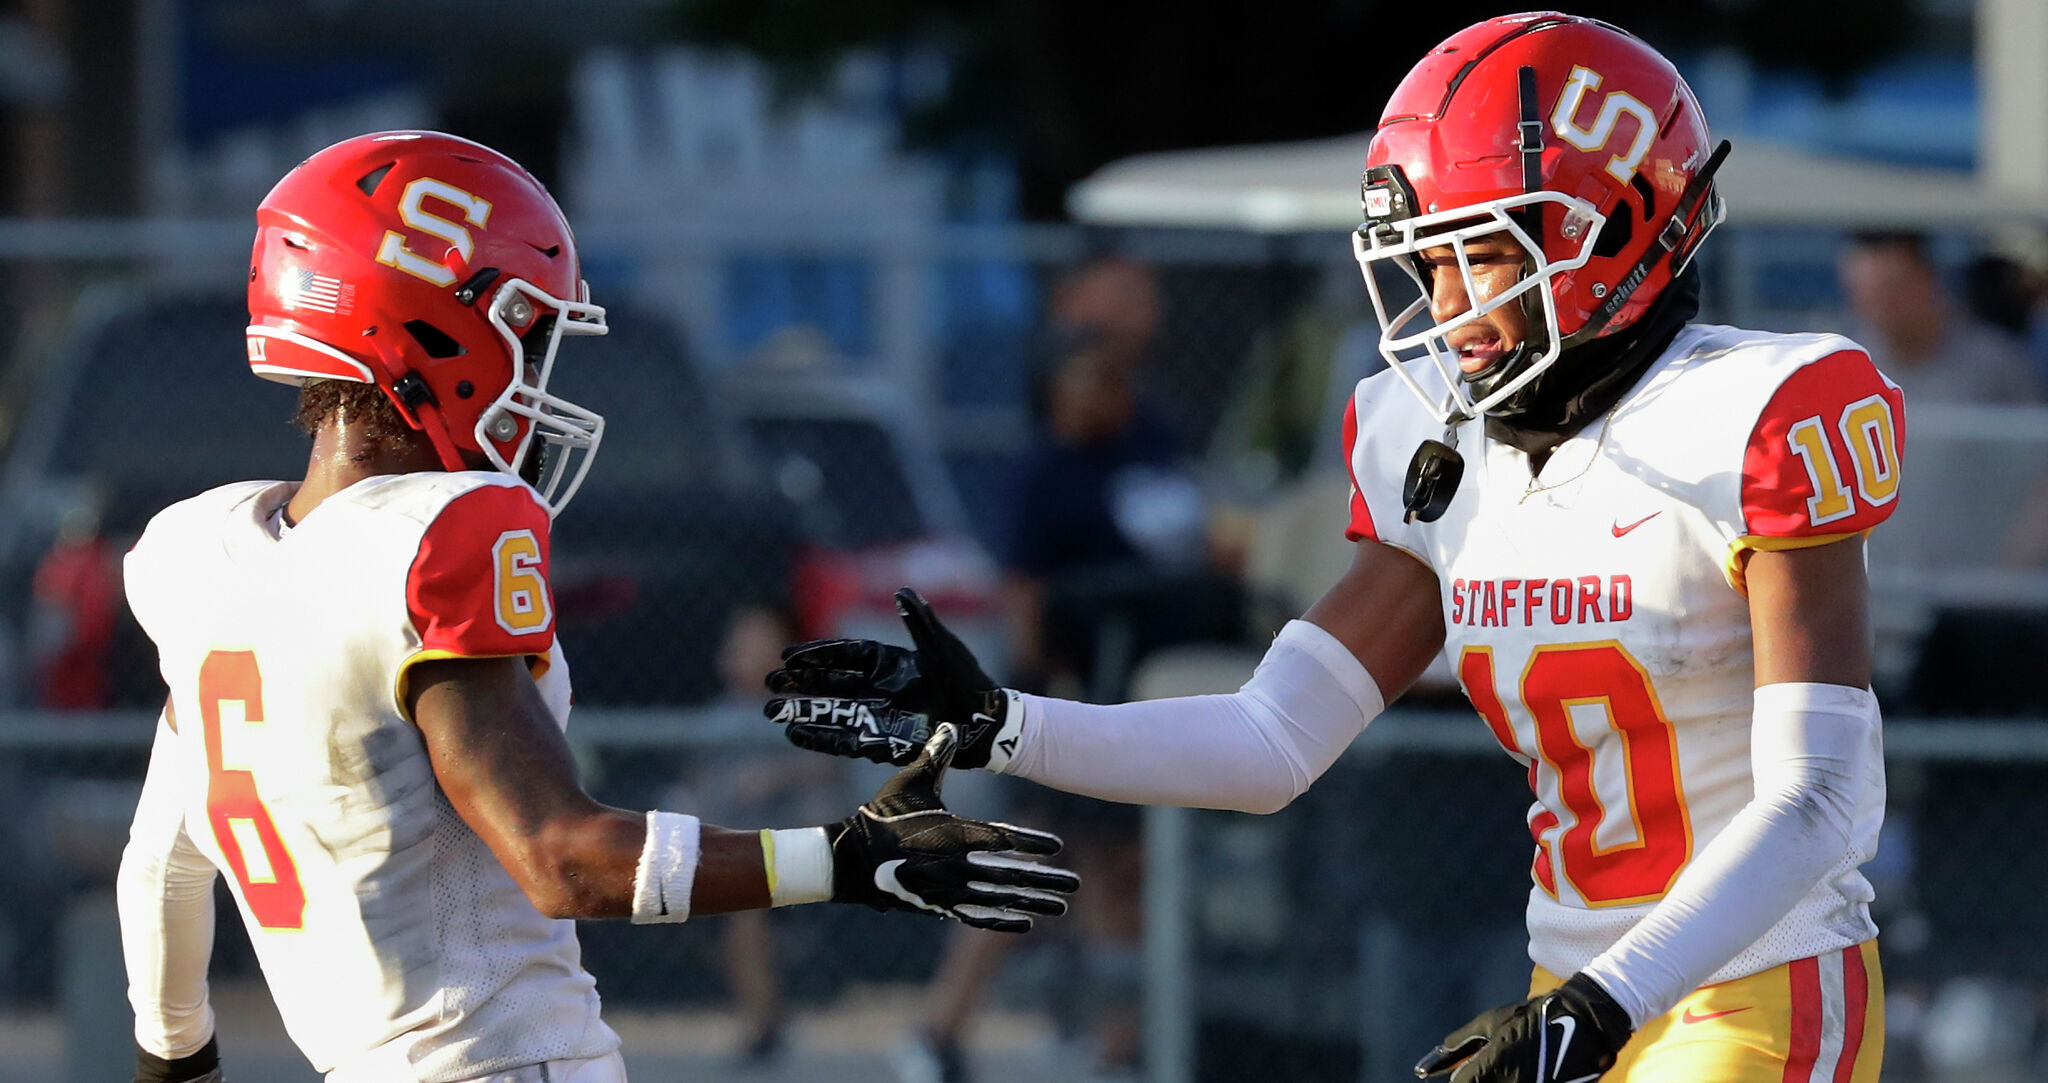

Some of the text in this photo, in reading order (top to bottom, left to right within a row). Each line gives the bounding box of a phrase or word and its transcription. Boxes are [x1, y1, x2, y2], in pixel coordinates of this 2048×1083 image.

[1550, 64, 1659, 187] S
[375, 177, 492, 288] S
[1605, 263, 1648, 316] schutt
[1787, 394, 1900, 526] 10
[492, 529, 553, 635] 6
[1453, 574, 1632, 627] STAFFORD
[770, 698, 880, 735] ALPHA
[199, 646, 306, 932] 6
[1458, 639, 1694, 909] 10
